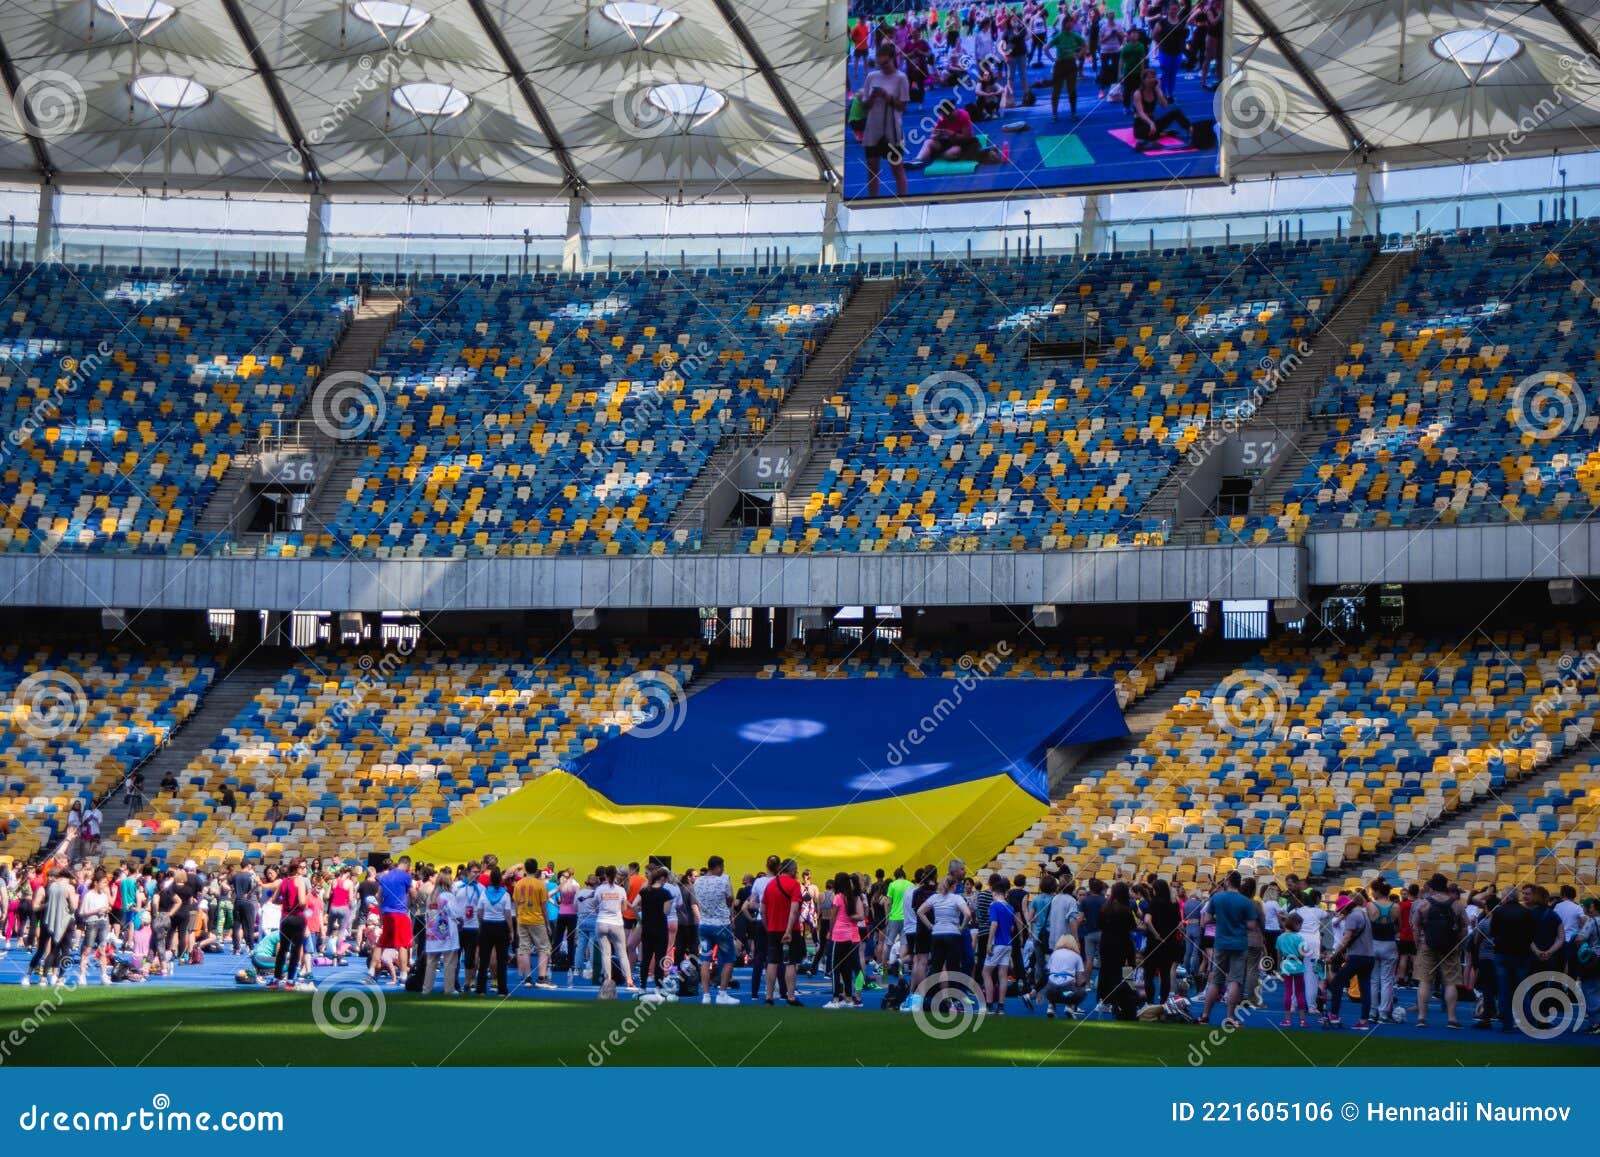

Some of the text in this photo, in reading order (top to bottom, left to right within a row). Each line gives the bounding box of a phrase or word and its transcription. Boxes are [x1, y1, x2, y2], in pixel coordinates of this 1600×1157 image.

[1242, 441, 1276, 464] 52
[281, 462, 315, 481] 56
[757, 456, 792, 478] 54
